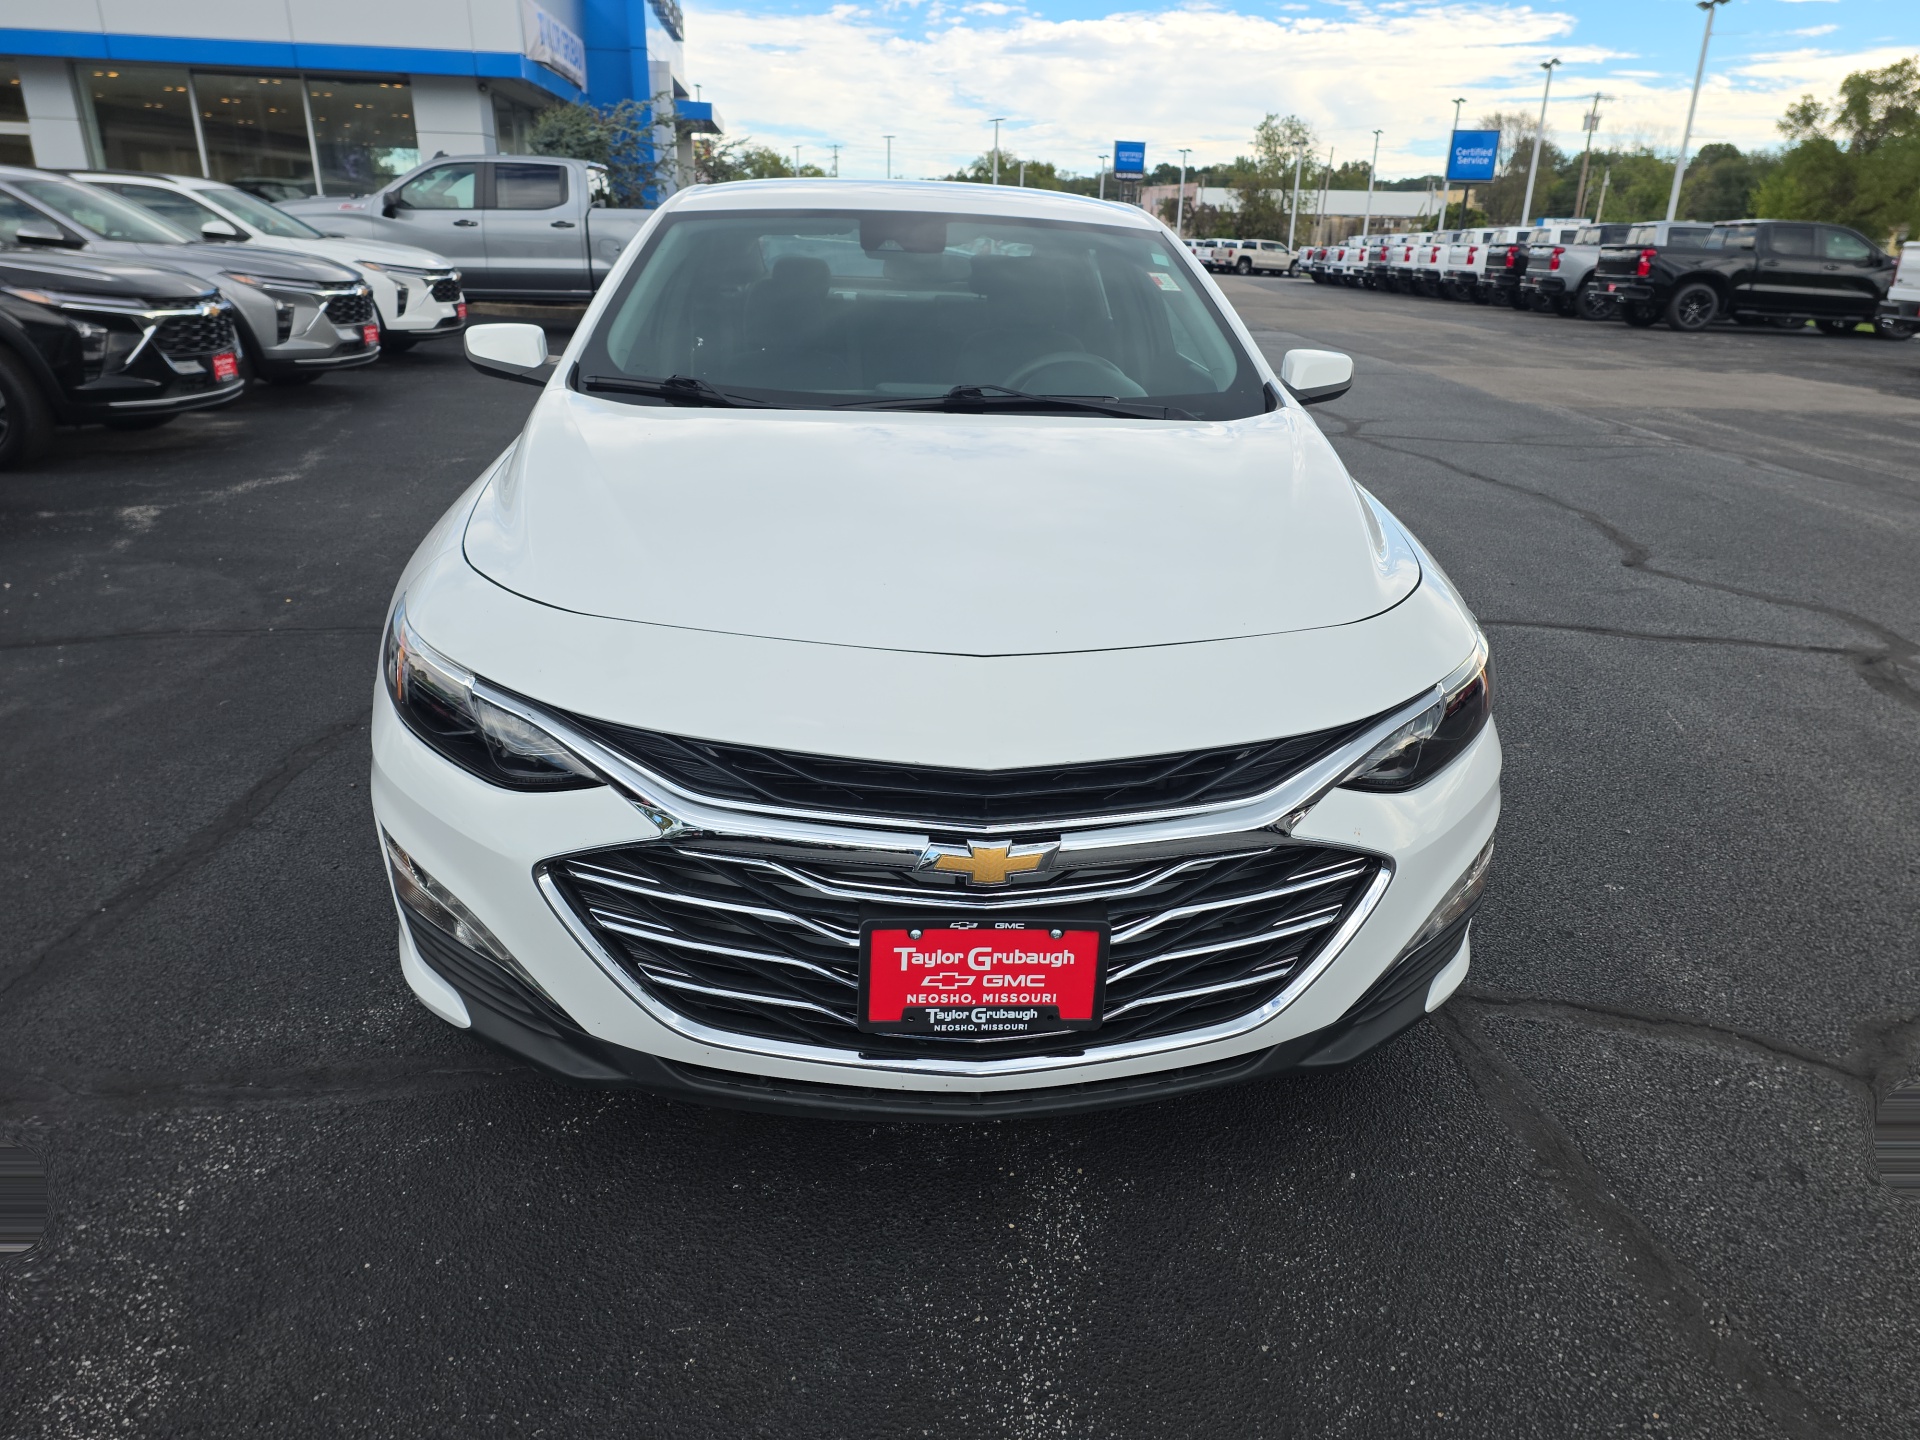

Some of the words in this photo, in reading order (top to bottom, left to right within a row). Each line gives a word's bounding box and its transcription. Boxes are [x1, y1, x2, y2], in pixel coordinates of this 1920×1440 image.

[1455, 147, 1493, 157] Certified
[1456, 155, 1490, 165] Service
[994, 922, 1025, 930] GMC
[893, 947, 964, 972] Taylor
[967, 946, 1075, 971] Grubaugh
[982, 974, 1046, 988] GMC
[906, 993, 976, 1005] NEOSHO,
[982, 993, 1057, 1003] MISSOURI
[925, 1008, 969, 1023] Taylor
[970, 1007, 1038, 1023] Grubaugh
[933, 1024, 978, 1032] NEOSHO,
[980, 1023, 1028, 1031] MISSOURI
